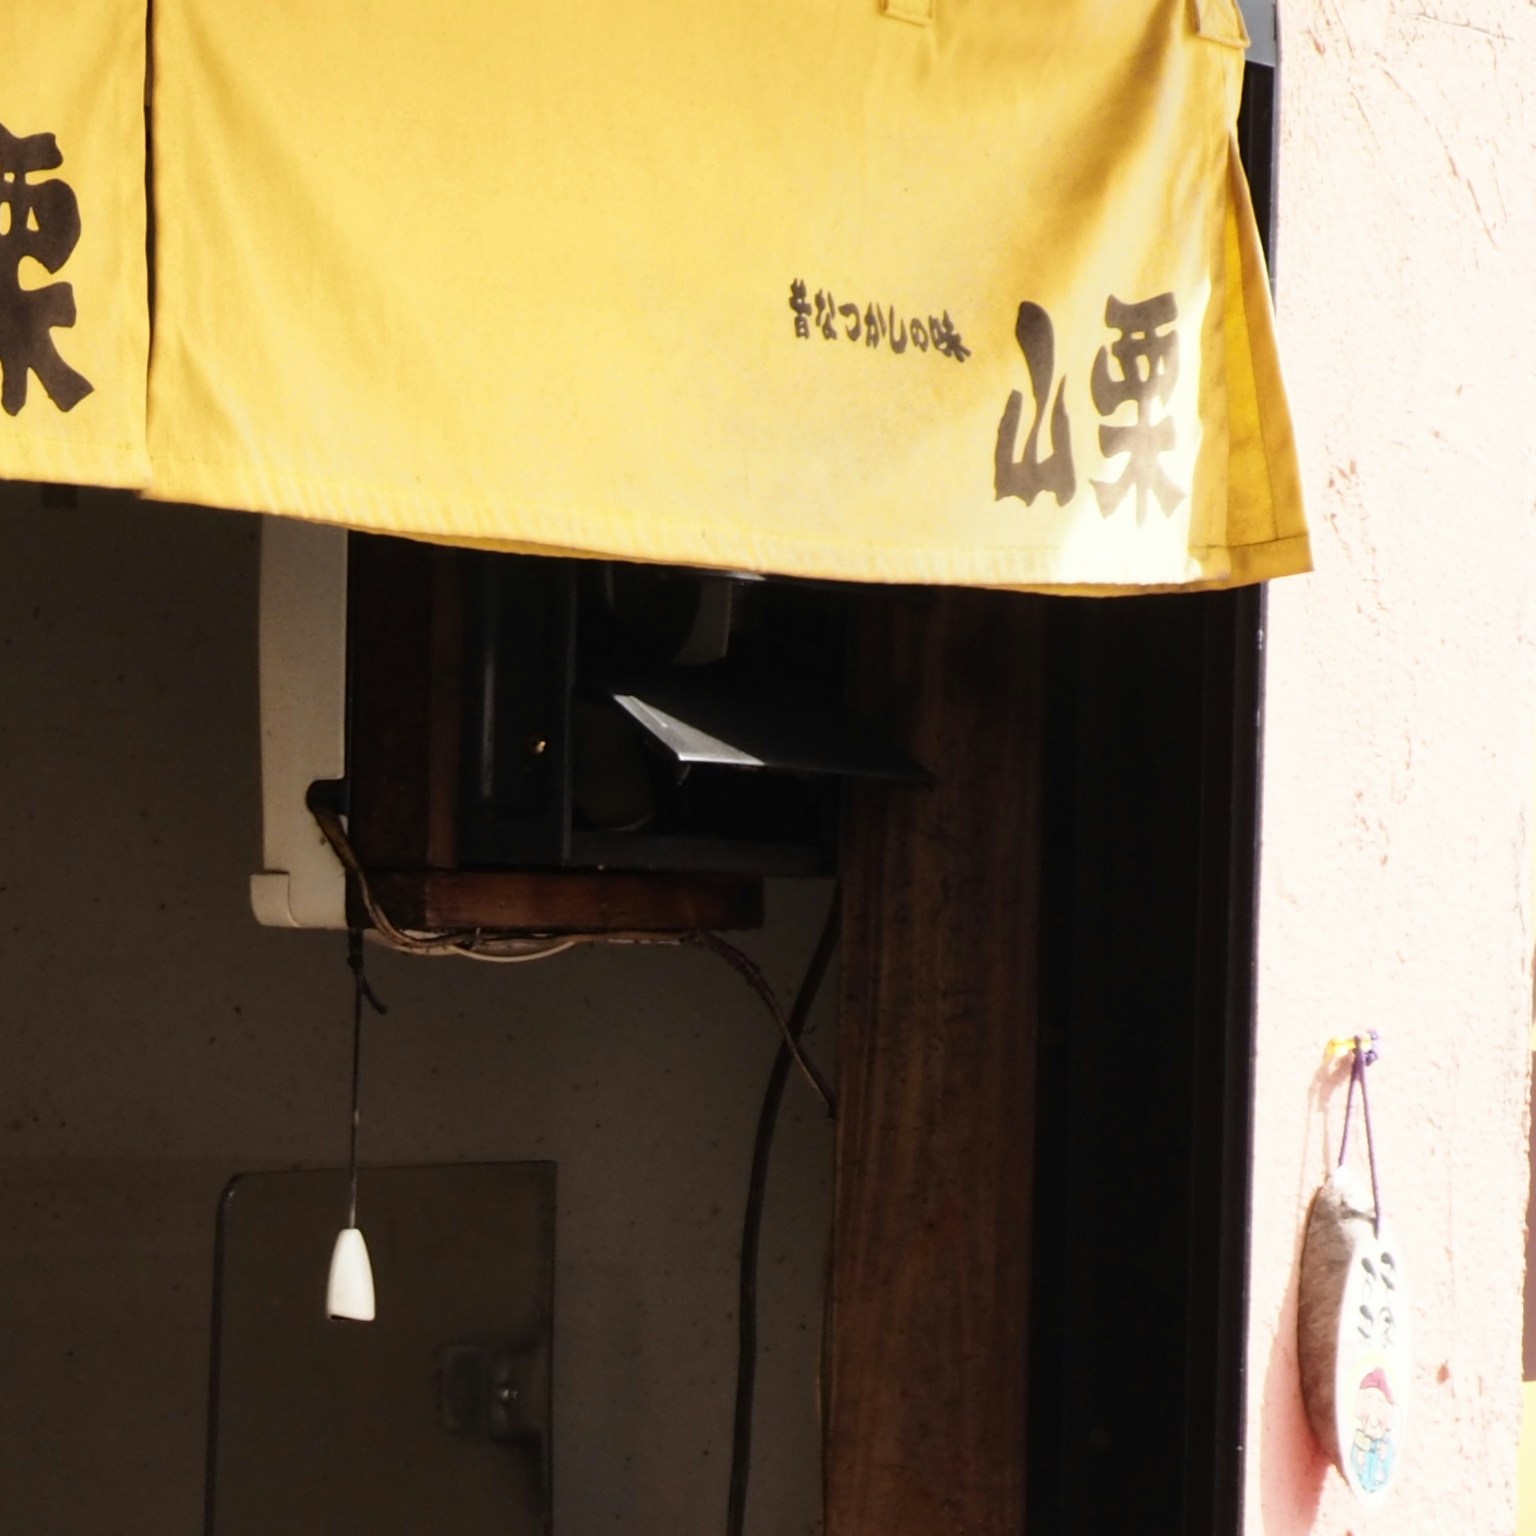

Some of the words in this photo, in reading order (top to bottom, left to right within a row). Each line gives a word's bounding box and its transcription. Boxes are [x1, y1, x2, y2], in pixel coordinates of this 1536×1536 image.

[789, 278, 971, 363] 昔なつかしの味
[994, 291, 1186, 526] 山栗
